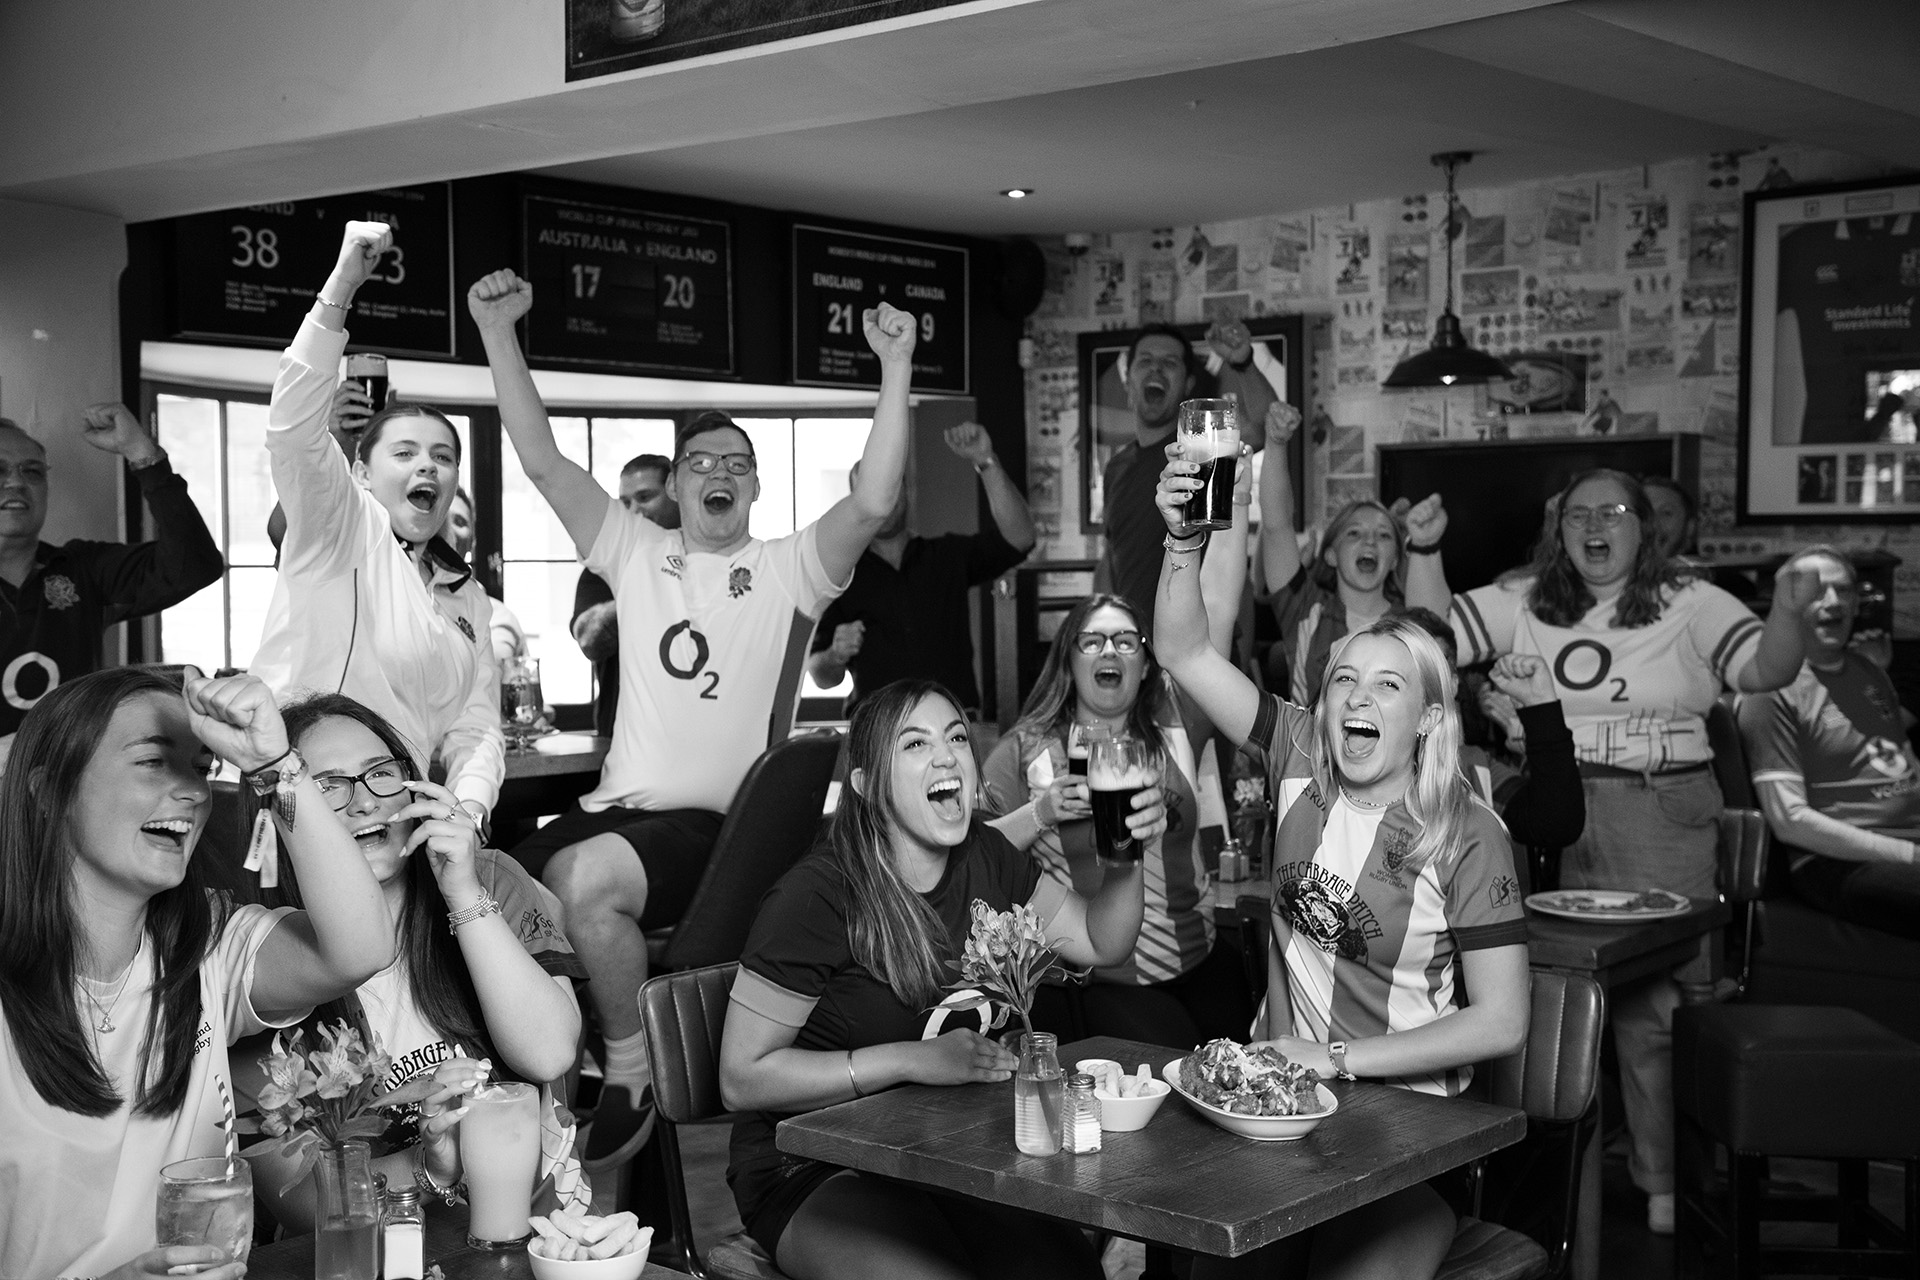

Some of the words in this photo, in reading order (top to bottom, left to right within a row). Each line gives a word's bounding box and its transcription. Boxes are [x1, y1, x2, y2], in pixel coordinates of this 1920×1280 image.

[231, 225, 280, 269] 38
[539, 227, 628, 254] AUSTRALIA
[646, 240, 718, 264] ENGLAND
[571, 264, 600, 298] 17
[663, 273, 696, 310] 20
[812, 272, 863, 292] ENGLAND
[905, 283, 946, 301] CANADA
[827, 302, 853, 335] 21
[921, 312, 935, 343] 9
[1824, 305, 1882, 320] Standard
[1884, 303, 1911, 317] Life
[1832, 317, 1911, 332] Investments
[659, 619, 720, 700] O2
[1554, 639, 1630, 702] O2
[1276, 861, 1296, 885] THE
[1297, 860, 1353, 901] CABBAGE
[1346, 891, 1384, 940] PATCH
